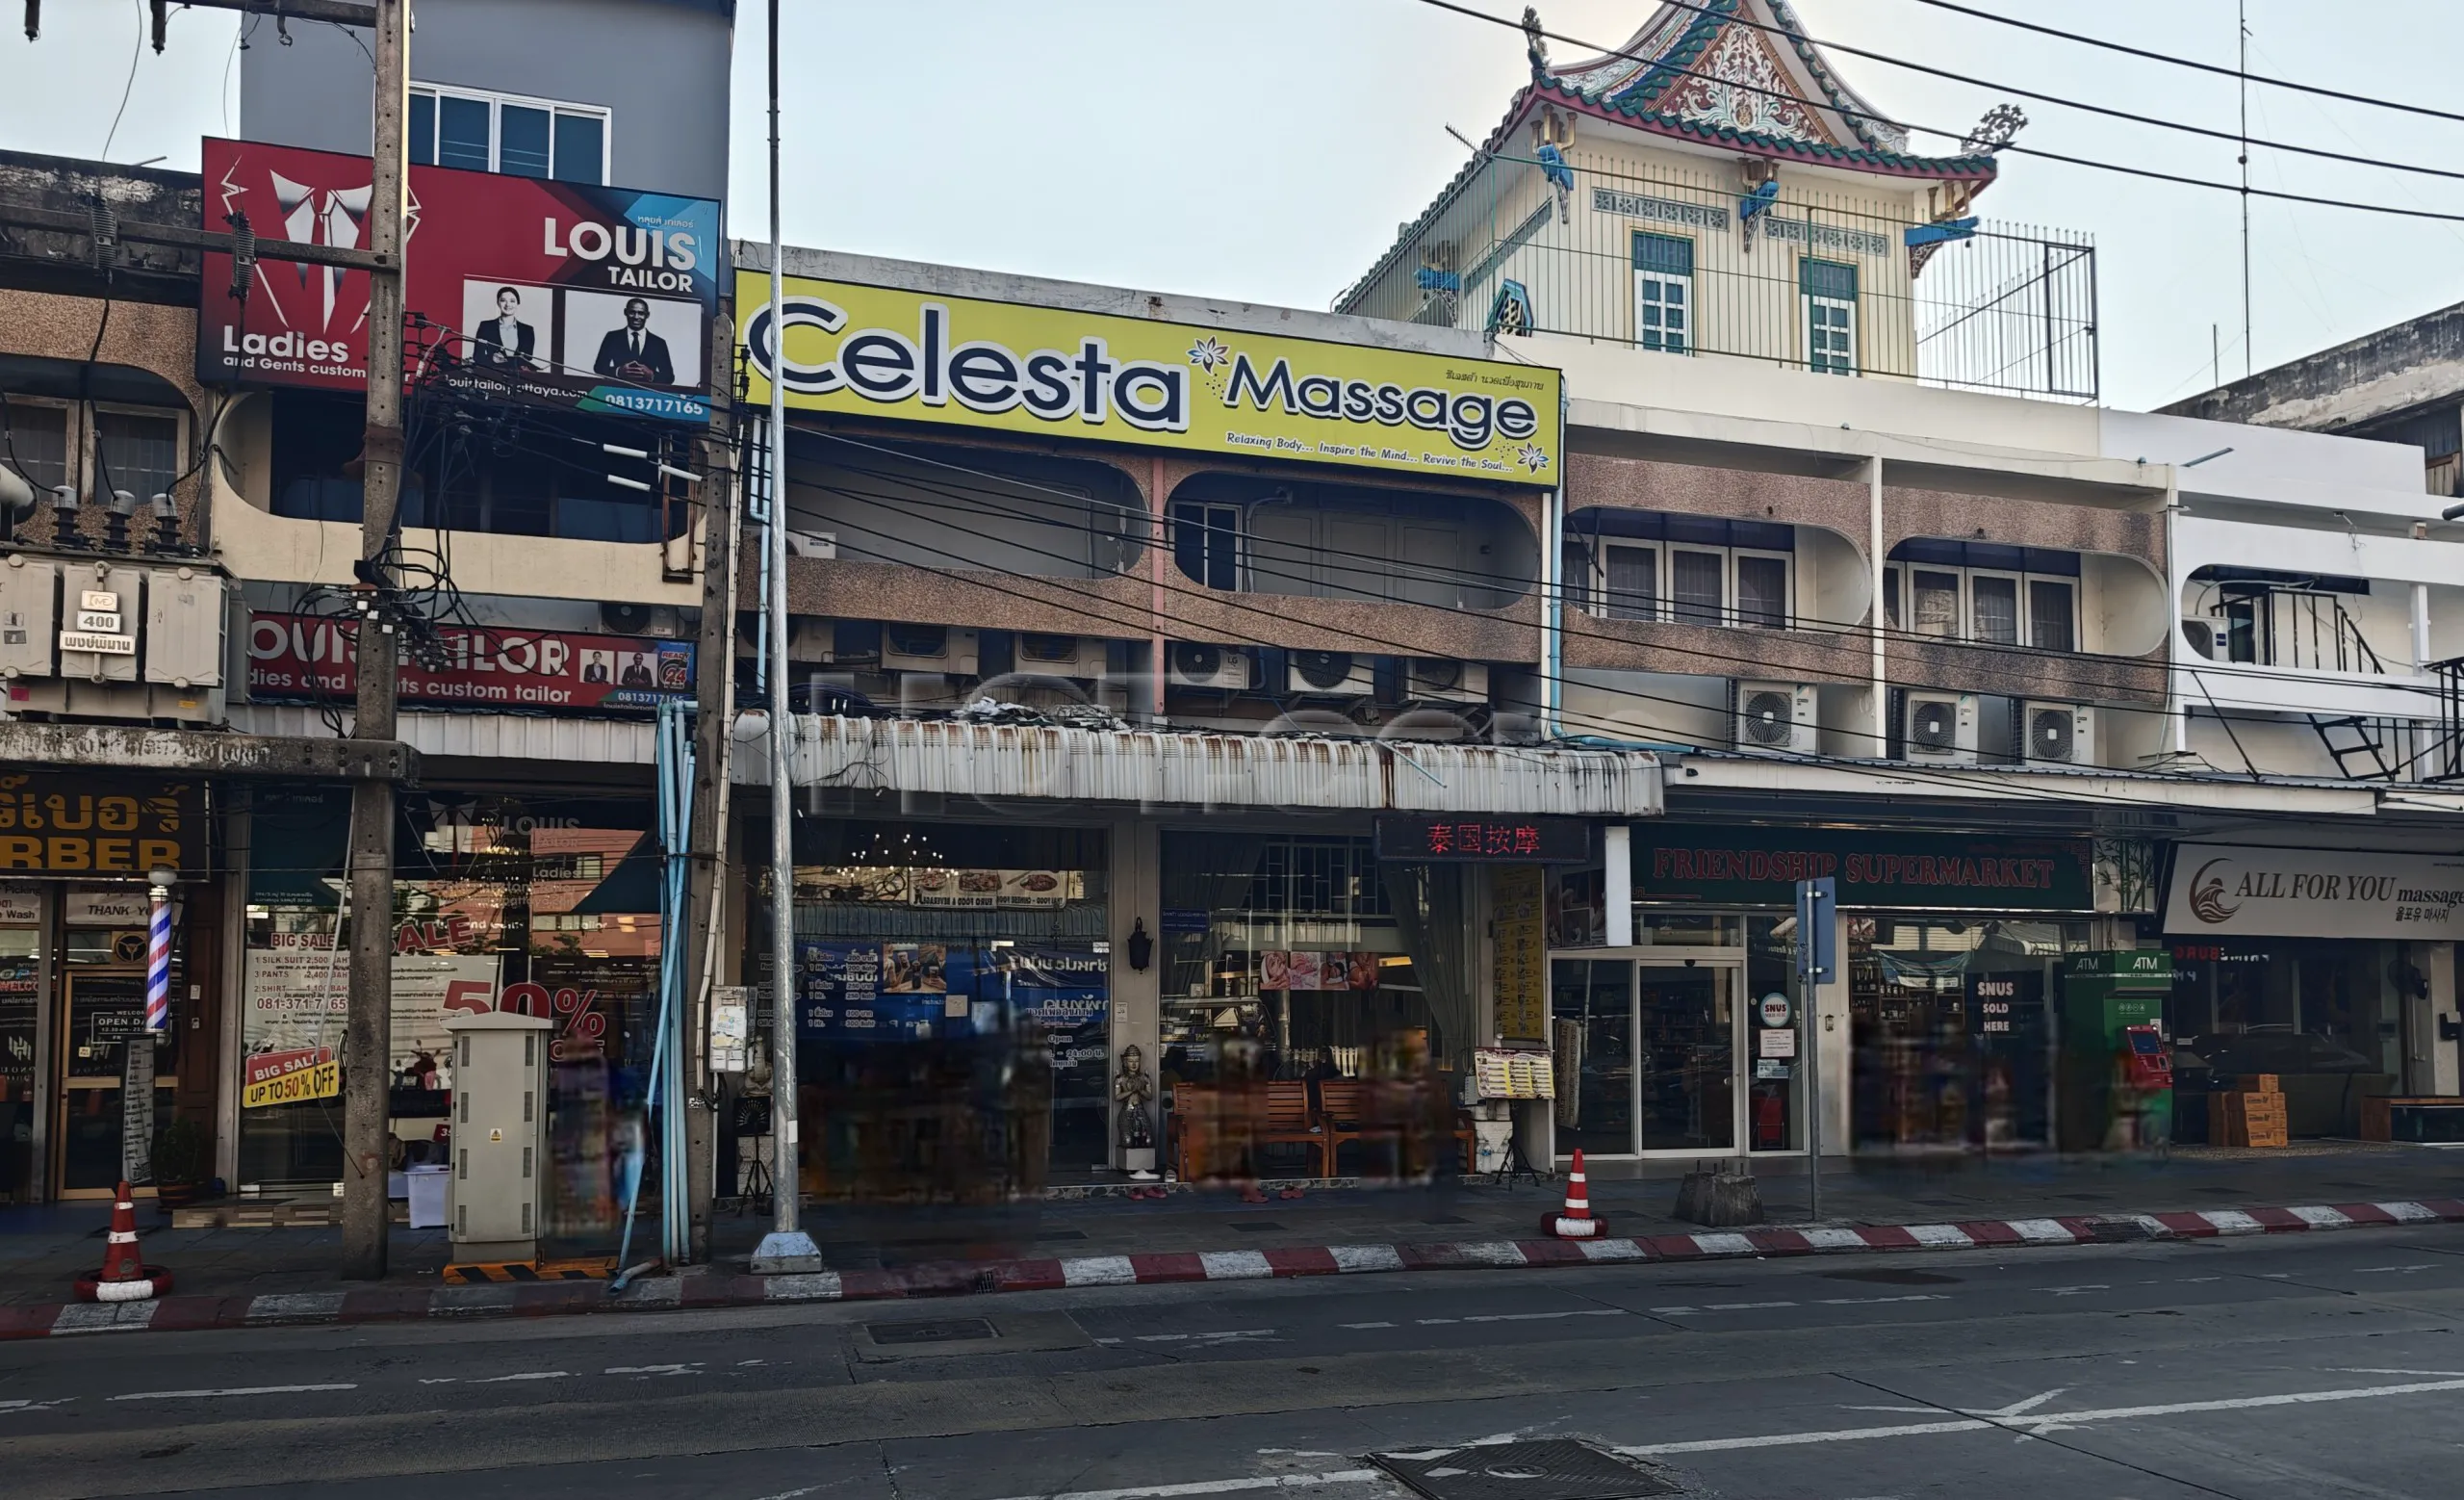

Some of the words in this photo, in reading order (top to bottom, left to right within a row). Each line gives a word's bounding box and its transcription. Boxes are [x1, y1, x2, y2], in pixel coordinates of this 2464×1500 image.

[543, 217, 698, 271] LOUIS
[607, 267, 693, 293] TAILOR
[223, 325, 349, 363] Ladies
[260, 359, 305, 373] Gents
[310, 365, 366, 378] custom
[749, 298, 1188, 429] Celesta
[605, 394, 704, 416] 0813717165
[1224, 351, 1538, 448] Massage
[1227, 432, 1271, 450] Relaxing
[1276, 437, 1313, 453] Body...
[1319, 442, 1355, 458] Inspire
[1360, 446, 1376, 457] the
[1381, 449, 1418, 462] Mind...
[1424, 453, 1456, 466] Revive
[1461, 456, 1476, 469] the
[1481, 459, 1513, 473] Soul...
[83, 615, 115, 628] 400
[426, 680, 510, 701] custom
[515, 685, 572, 704] tailor
[503, 815, 581, 840] LOUIS
[1426, 823, 1542, 855] 泰国按摩
[1652, 847, 1837, 883] FRIENDSHIP
[1845, 853, 2055, 890] SUPERMARKET
[5, 885, 41, 896] Picking
[2234, 872, 2287, 899] ALL
[2290, 874, 2340, 901] FOR
[2347, 874, 2398, 902] YOU
[2397, 889, 2464, 908] massage
[7, 909, 36, 919] Wash
[88, 905, 130, 917] THANK
[2396, 905, 2422, 922] 올포유
[2424, 907, 2450, 923] 마사지
[271, 933, 296, 948] BIG
[300, 933, 335, 948] SALE
[390, 916, 475, 952] ALE
[2075, 957, 2099, 971] ATM
[2132, 956, 2158, 970] ATM
[1977, 981, 2014, 997] SNUS
[256, 997, 347, 1010] 081-371-765
[1765, 1004, 1786, 1013] SNUS
[1983, 1002, 2009, 1014] SOLD
[1983, 1021, 2010, 1031] HERE
[1048, 1034, 1073, 1044] Open
[254, 1066, 280, 1080] BIG
[283, 1055, 321, 1070] SALE
[250, 1086, 266, 1103] UP
[269, 1081, 283, 1100] TO
[314, 1065, 335, 1094] OFF
